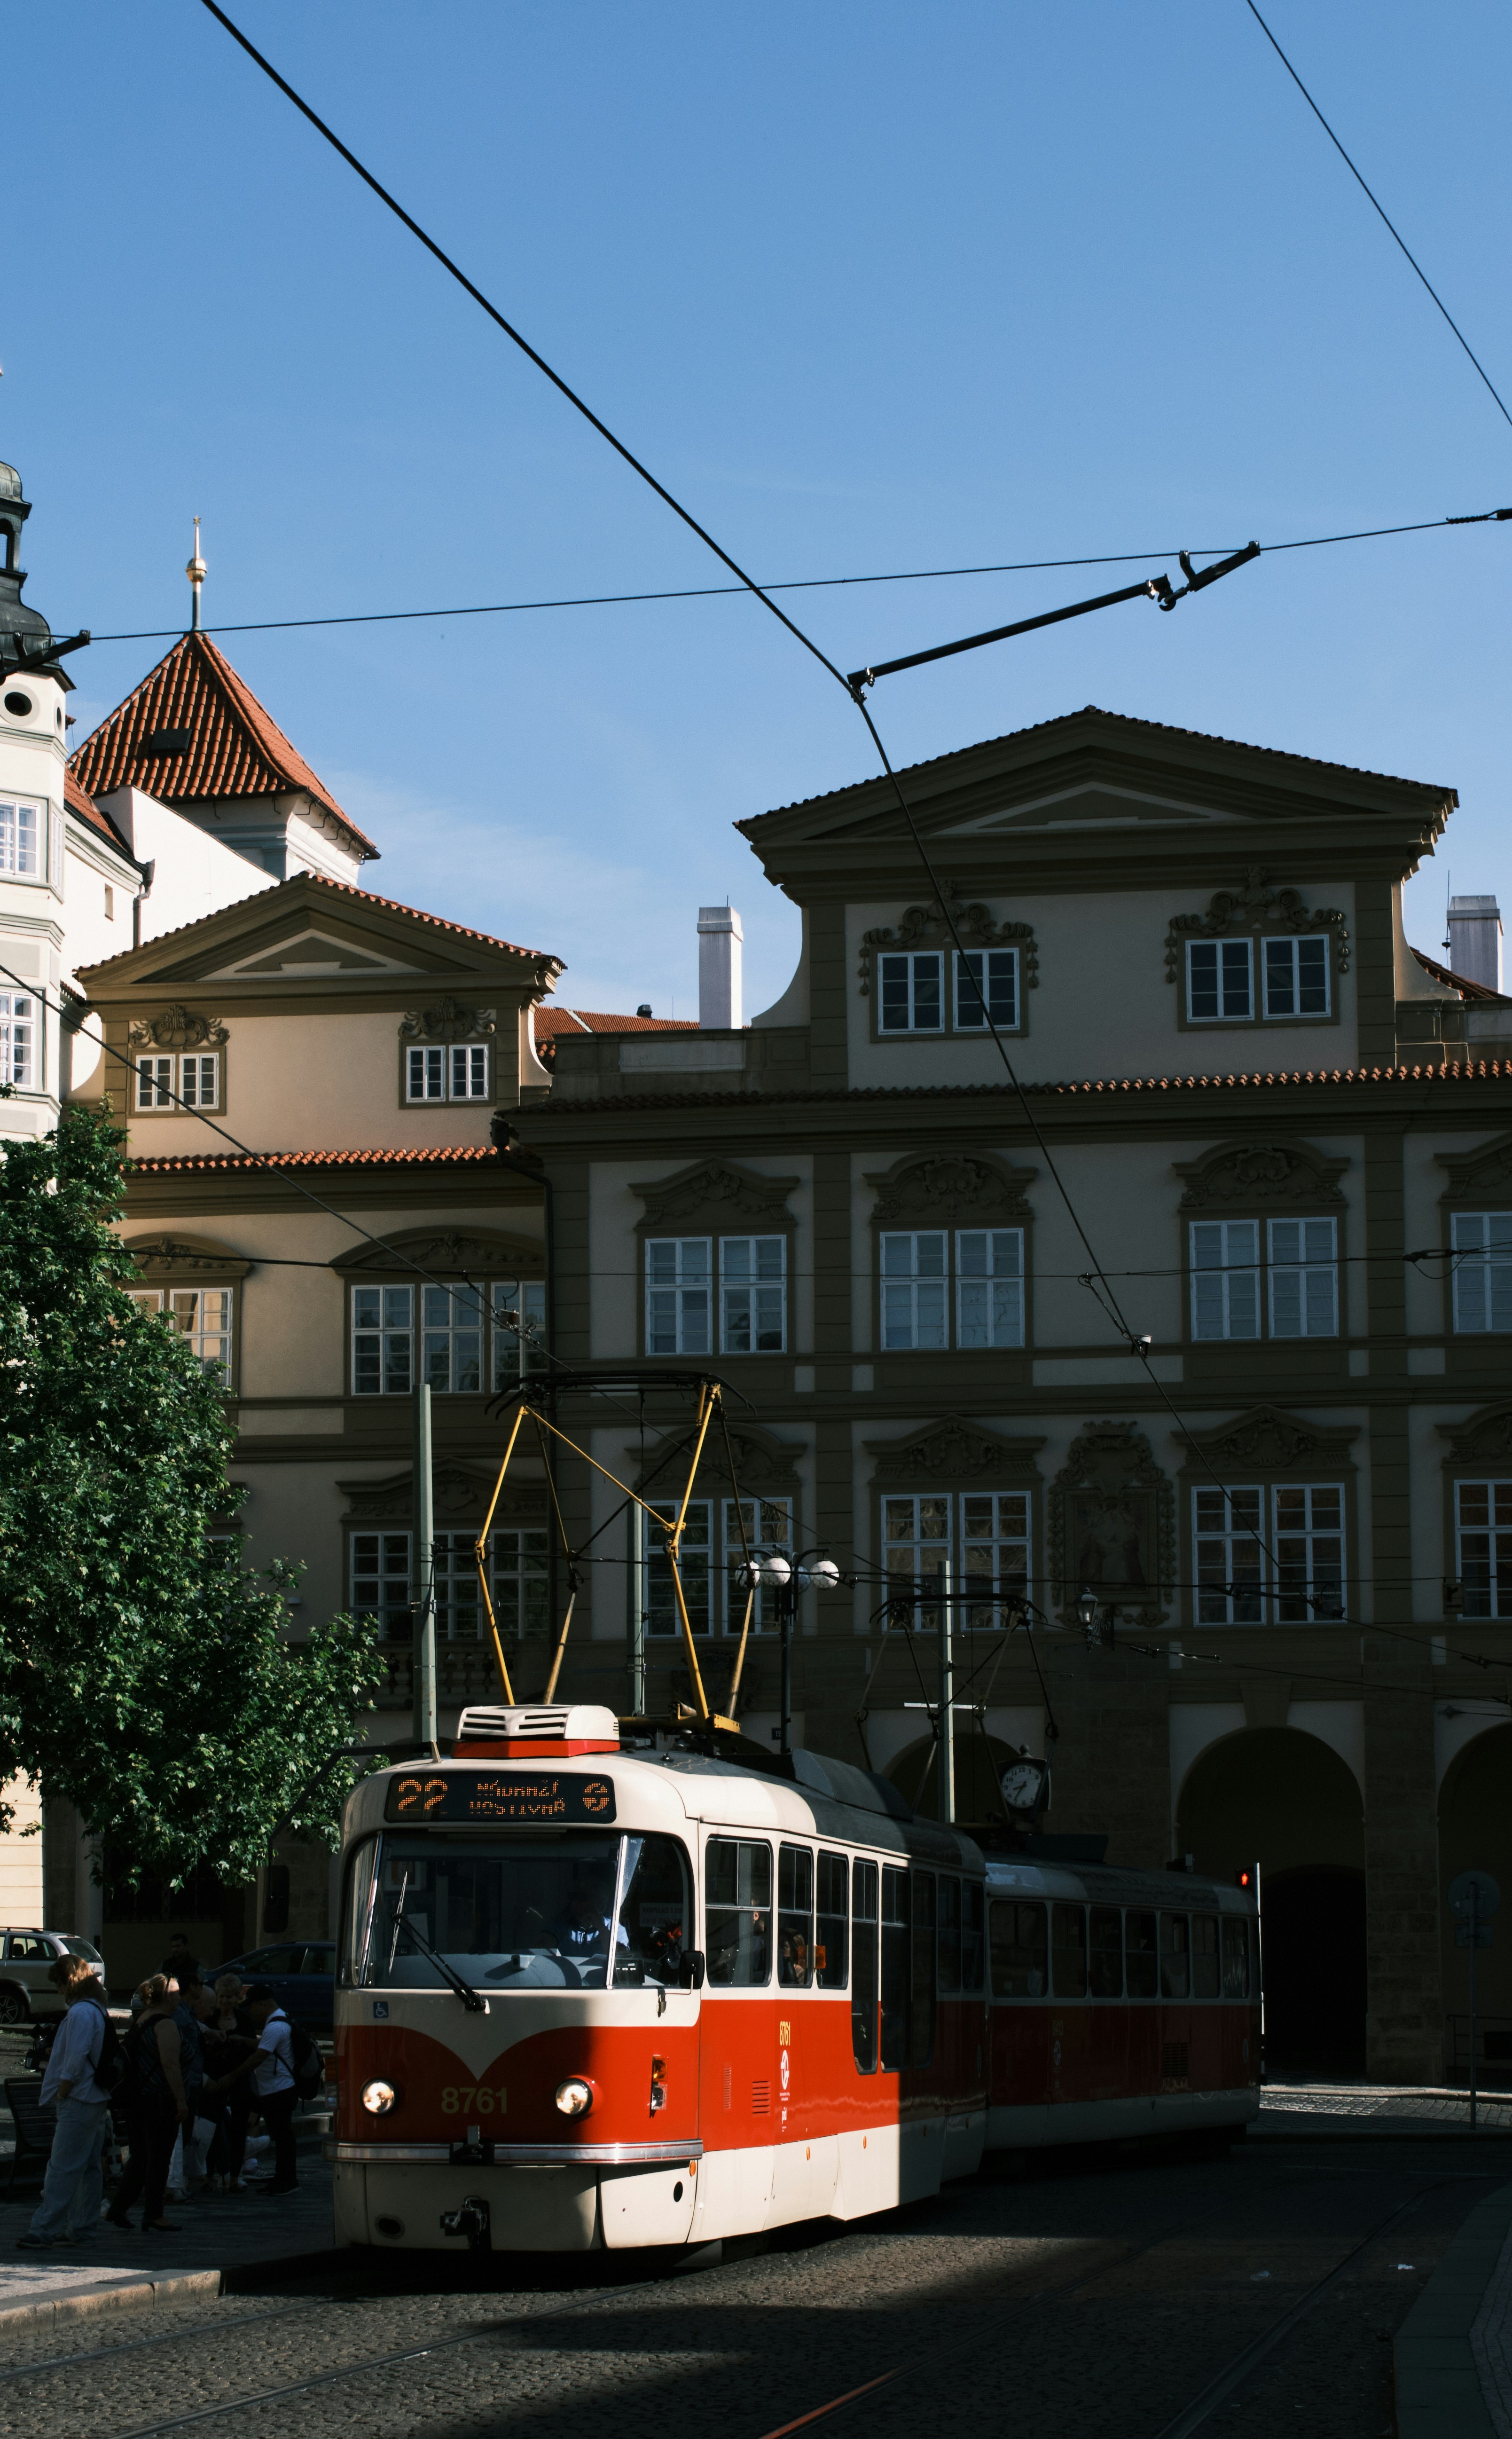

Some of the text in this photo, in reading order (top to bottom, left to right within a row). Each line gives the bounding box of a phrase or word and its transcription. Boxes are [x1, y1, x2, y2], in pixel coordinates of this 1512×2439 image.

[398, 1779, 448, 1813] 22
[780, 2021, 791, 2046] 8761
[441, 2086, 507, 2114] 8761
